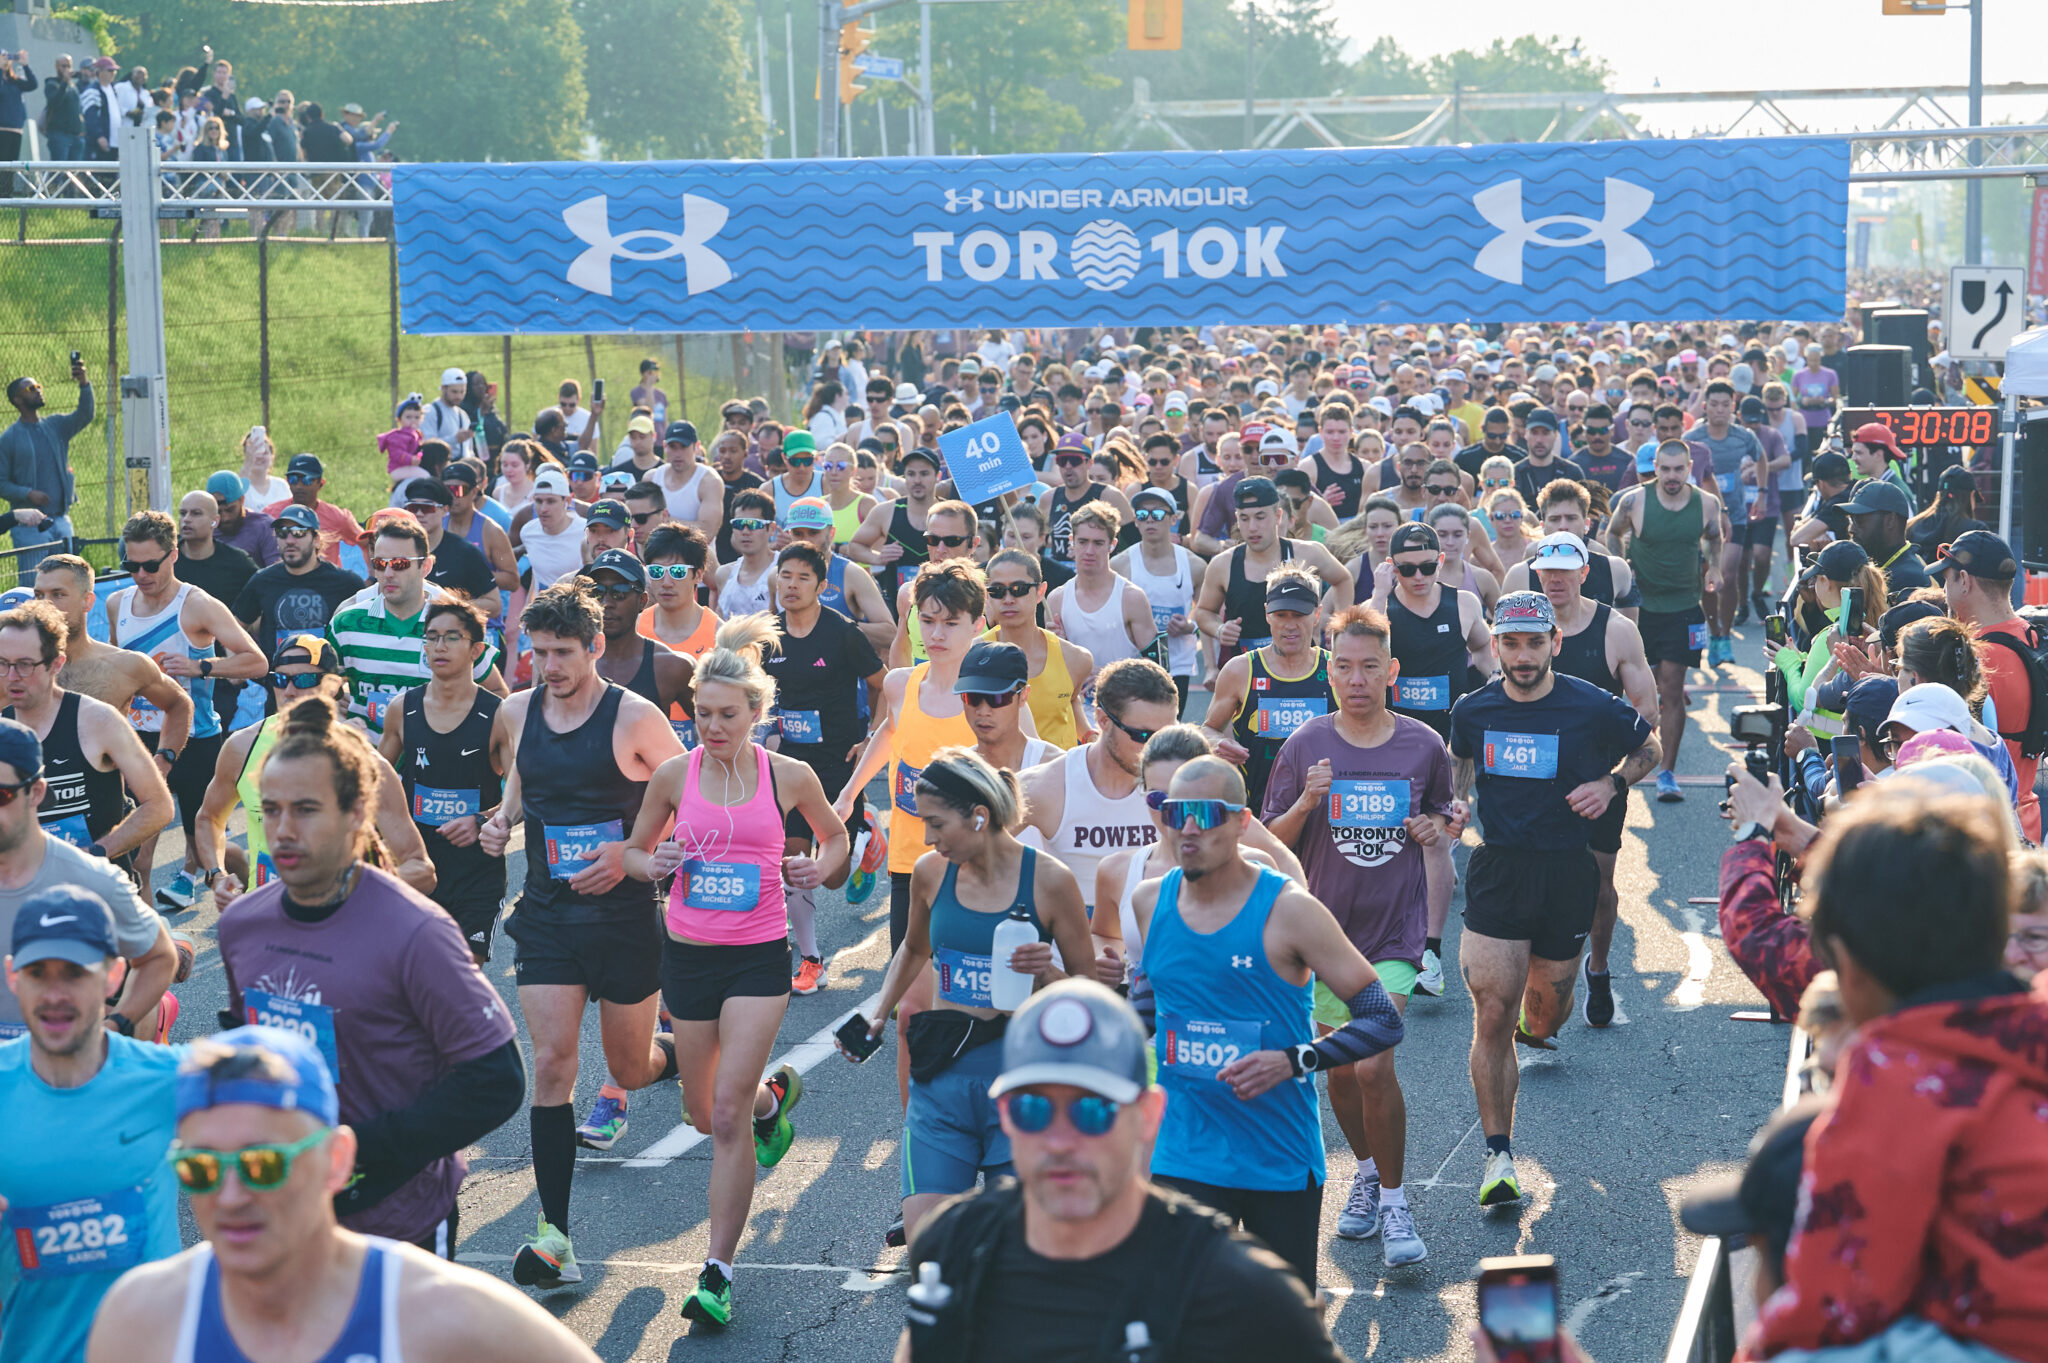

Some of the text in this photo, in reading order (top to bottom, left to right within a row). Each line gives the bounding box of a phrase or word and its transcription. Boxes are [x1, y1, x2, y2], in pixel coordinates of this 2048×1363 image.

[994, 187, 1250, 210] UNDER ARMOUR
[2032, 192, 2048, 291] CORRAL
[913, 226, 1288, 282] TOR 10K
[965, 431, 1001, 459] 40
[978, 456, 1003, 473] min
[288, 594, 322, 607] TOR
[1402, 686, 1437, 700] 3821
[782, 720, 812, 734] 4594
[1502, 745, 1537, 764] 461
[423, 798, 467, 815] 2750
[1345, 794, 1396, 813] 3189
[1073, 824, 1159, 848] POWER
[1332, 827, 1406, 841] TORONTO
[1354, 843, 1384, 856] 10K
[691, 875, 744, 896] 2635
[702, 895, 732, 904] MICHELE
[953, 968, 992, 992] 419
[1177, 1039, 1240, 1067] 5502
[37, 1213, 128, 1256] 2282
